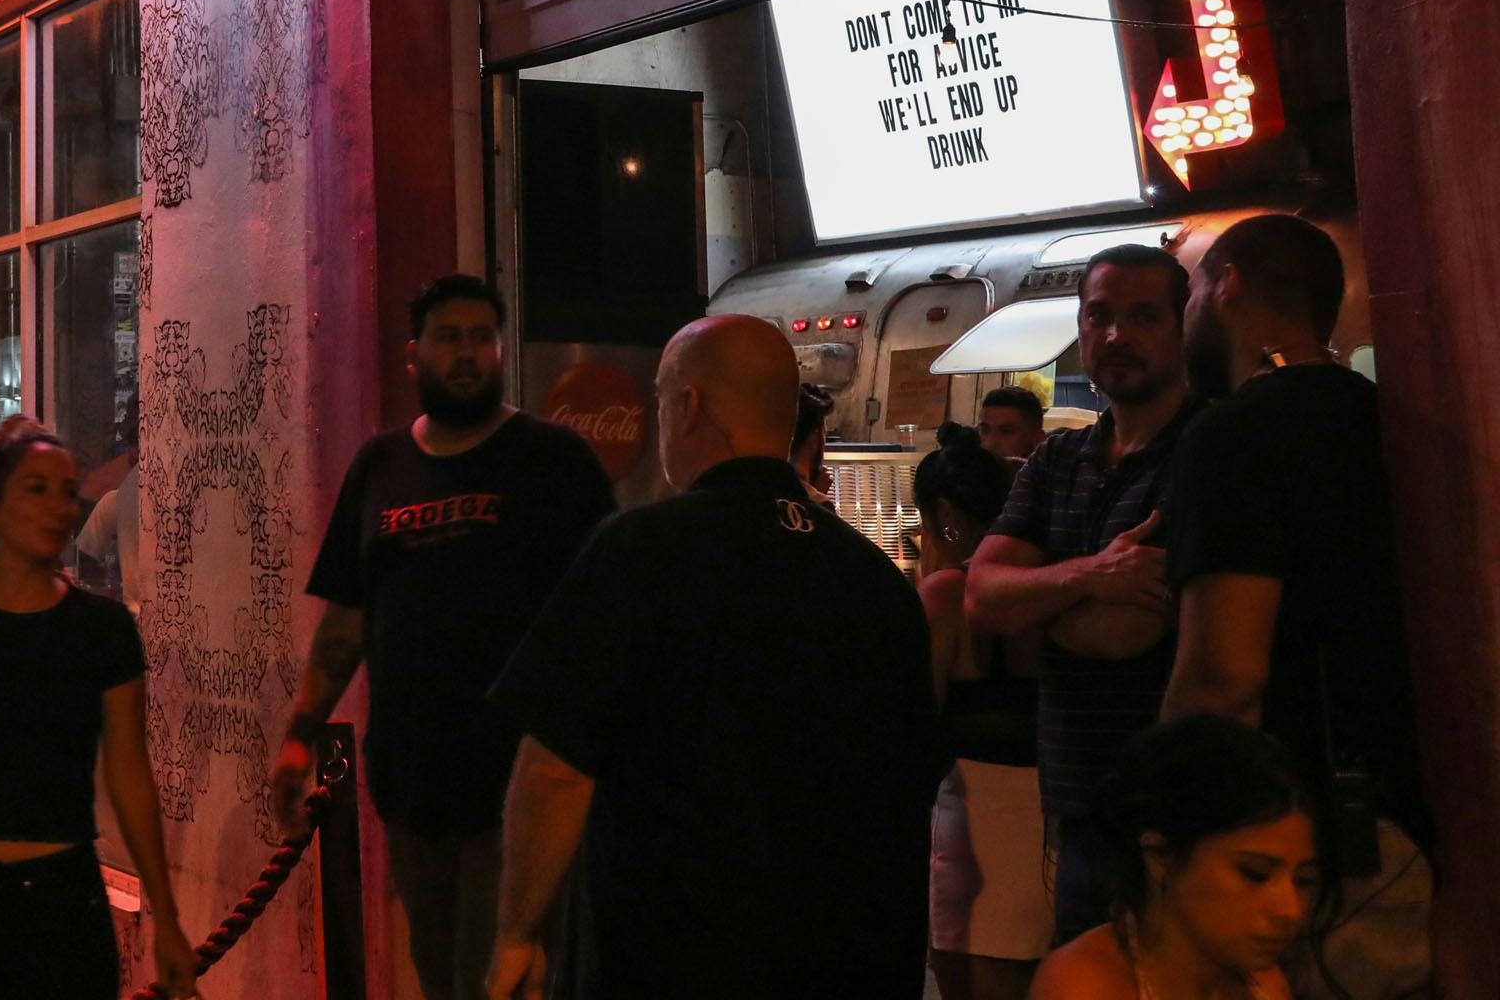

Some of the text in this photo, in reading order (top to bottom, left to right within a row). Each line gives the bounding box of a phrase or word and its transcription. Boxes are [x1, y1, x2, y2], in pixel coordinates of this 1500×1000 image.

[887, 49, 923, 87] FOR
[878, 75, 1019, 133] WE'LL END UP
[927, 127, 989, 169] DRUNK
